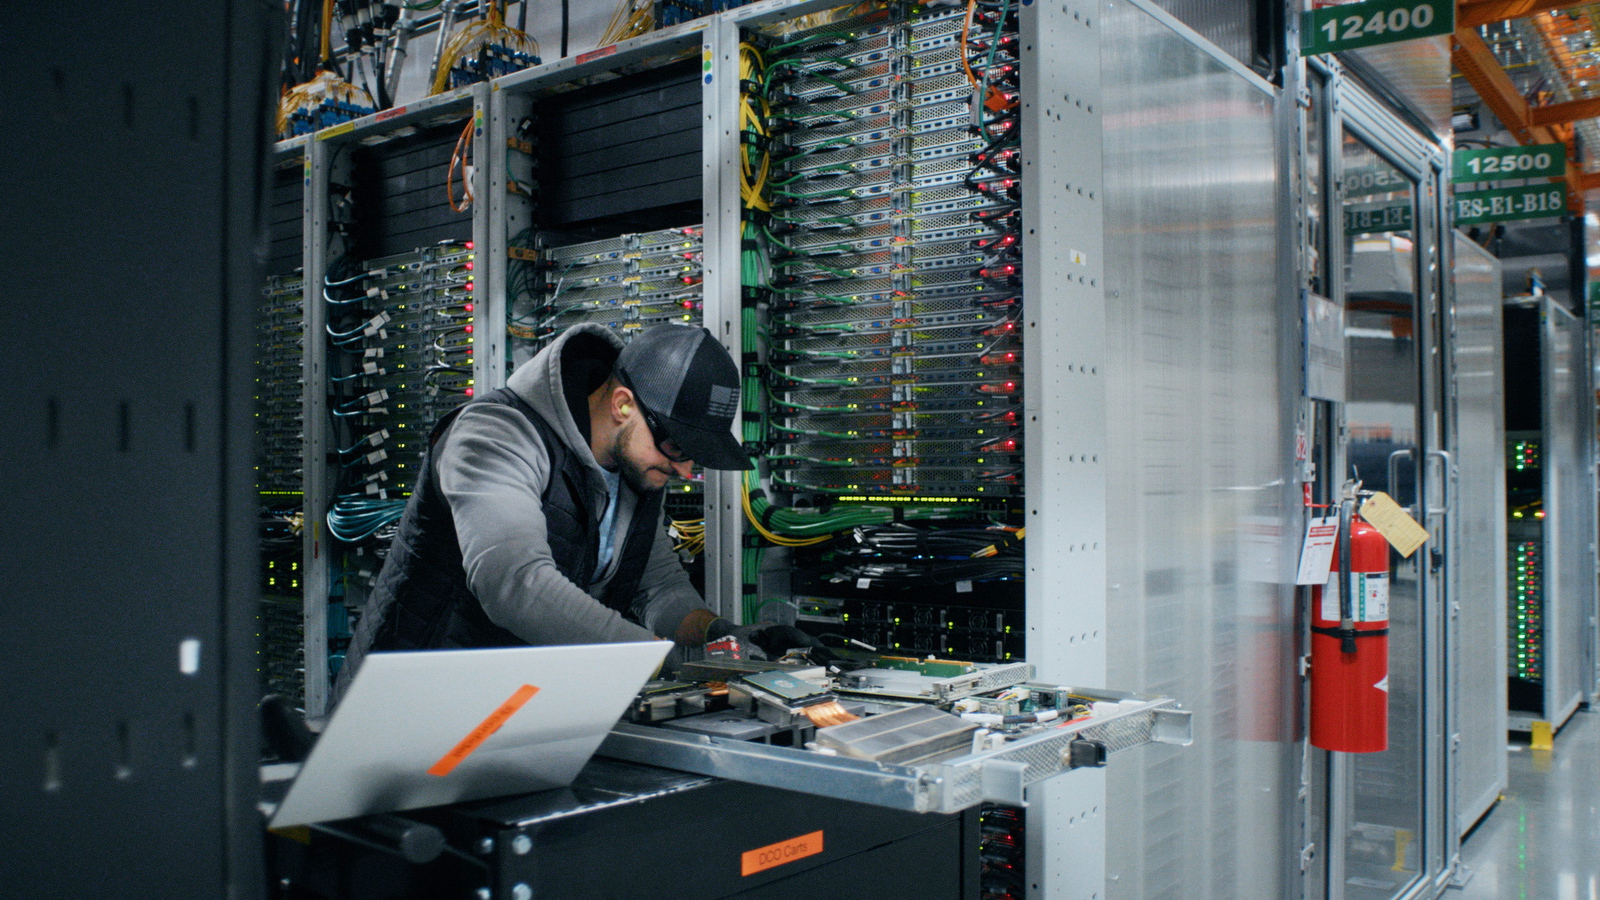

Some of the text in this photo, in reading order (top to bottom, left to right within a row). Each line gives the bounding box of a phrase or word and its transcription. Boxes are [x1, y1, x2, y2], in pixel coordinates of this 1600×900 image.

[1321, 3, 1434, 42] 12400
[1467, 152, 1552, 175] 12500
[1457, 191, 1562, 219] ES-E1-B18
[784, 843, 808, 858] Carts
